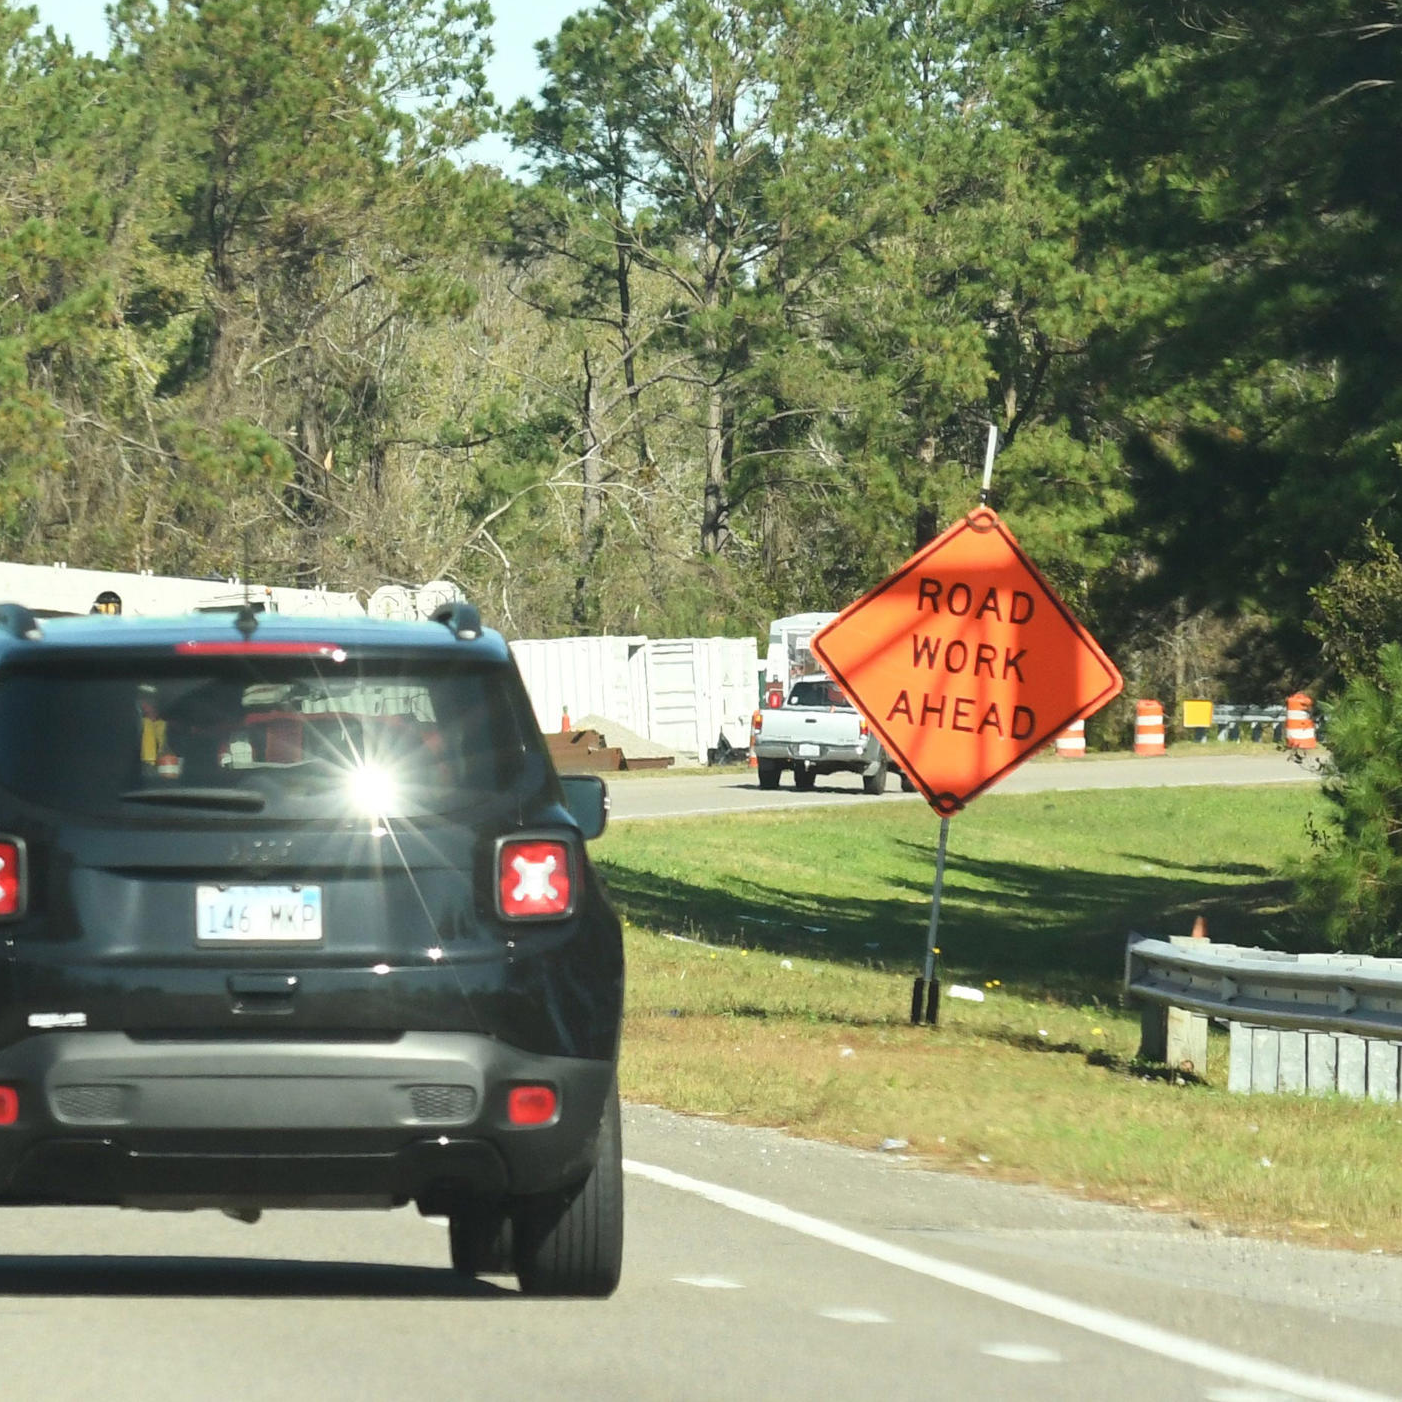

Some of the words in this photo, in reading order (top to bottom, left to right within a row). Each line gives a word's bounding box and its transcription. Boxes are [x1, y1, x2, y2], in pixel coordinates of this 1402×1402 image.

[918, 578, 1035, 625] ROAD
[912, 635, 1026, 684] WORK
[887, 690, 1037, 741] AHEAD
